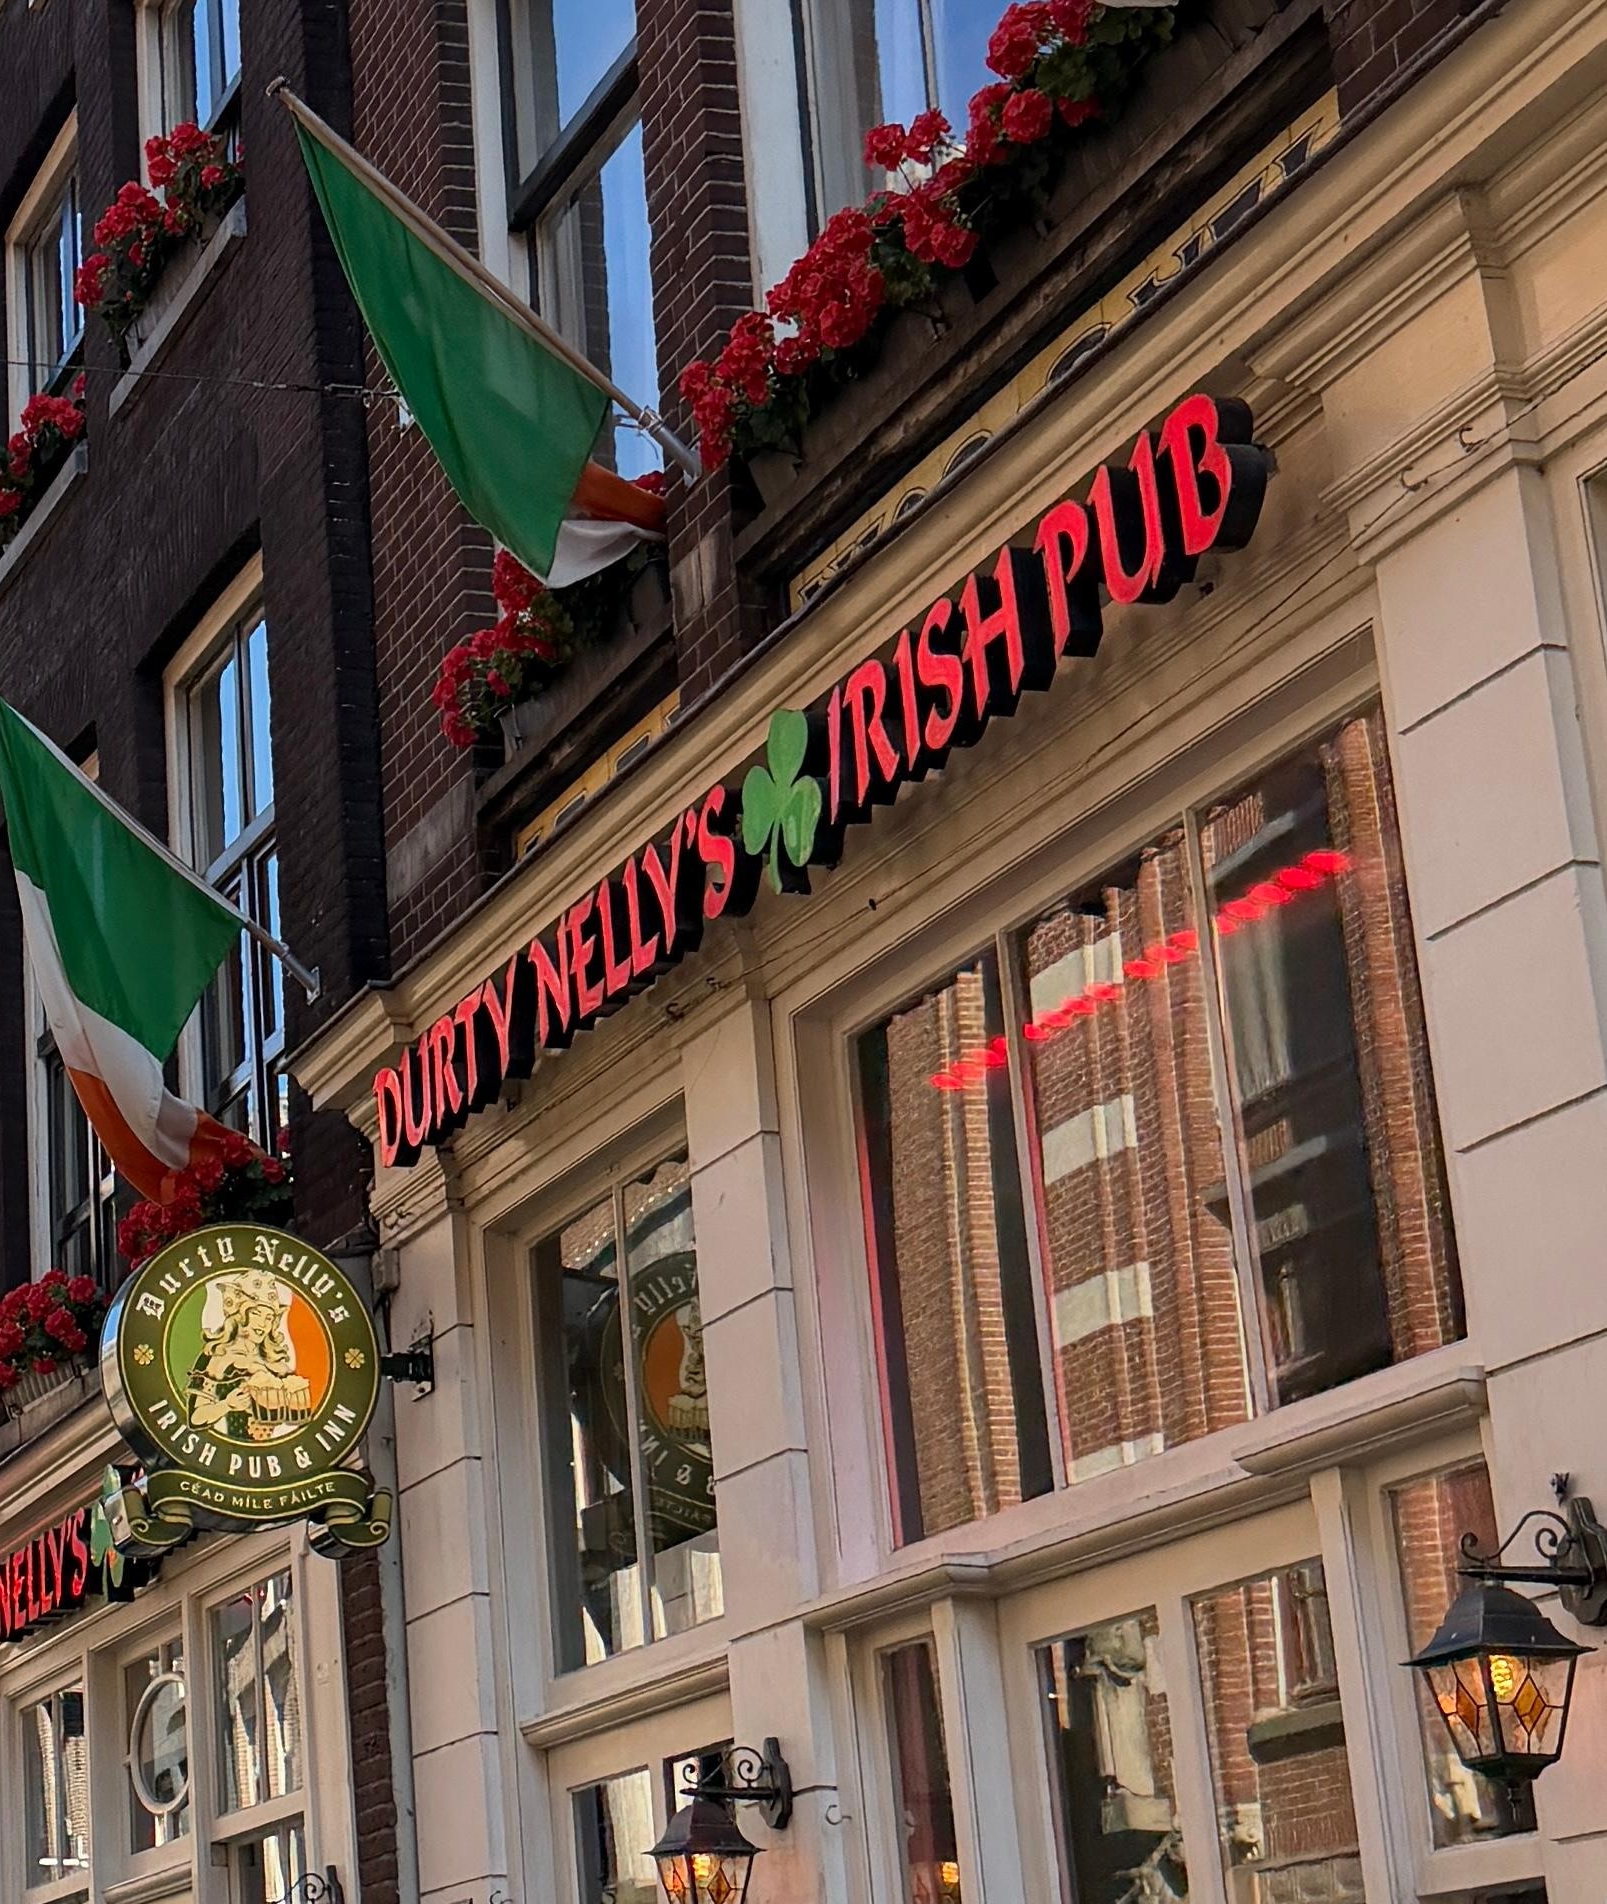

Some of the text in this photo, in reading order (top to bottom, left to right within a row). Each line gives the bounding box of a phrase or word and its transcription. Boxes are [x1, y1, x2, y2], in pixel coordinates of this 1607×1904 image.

[373, 392, 1233, 1167] DURTY NELLY'S IRISH PUB
[136, 1235, 350, 1324] Durty Nelly's
[148, 1399, 357, 1478] IRISH PUB & INN
[180, 1480, 336, 1510] CÉAD MÍLE FÁILTE
